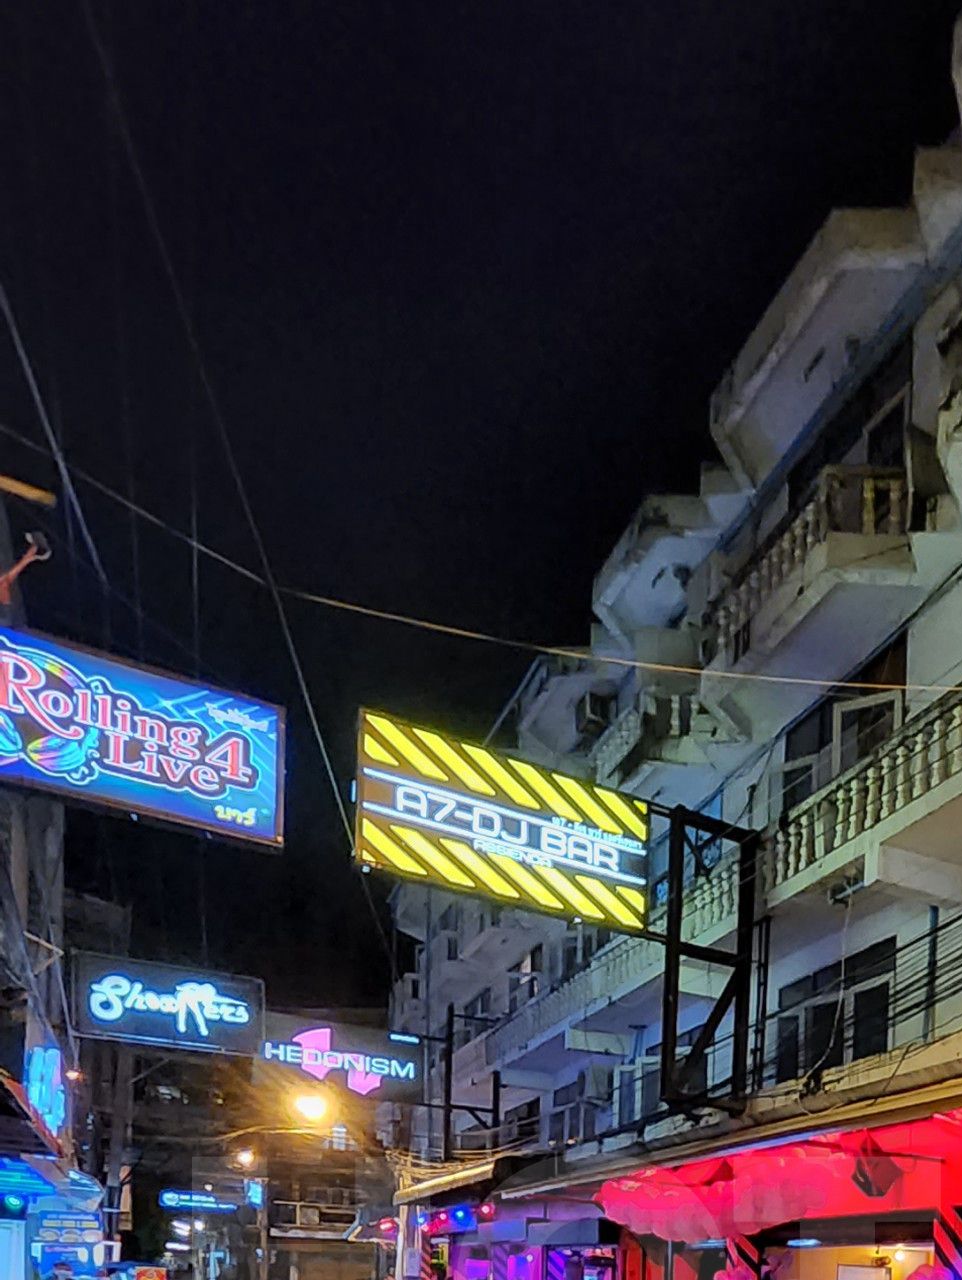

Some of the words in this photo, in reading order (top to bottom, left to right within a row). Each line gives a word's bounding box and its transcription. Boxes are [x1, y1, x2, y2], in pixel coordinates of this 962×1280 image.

[0, 651, 201, 760] Rolling
[103, 730, 220, 791] Live
[205, 735, 252, 782] 4
[540, 829, 621, 872] BAR
[264, 1042, 416, 1079] HEDONISM
